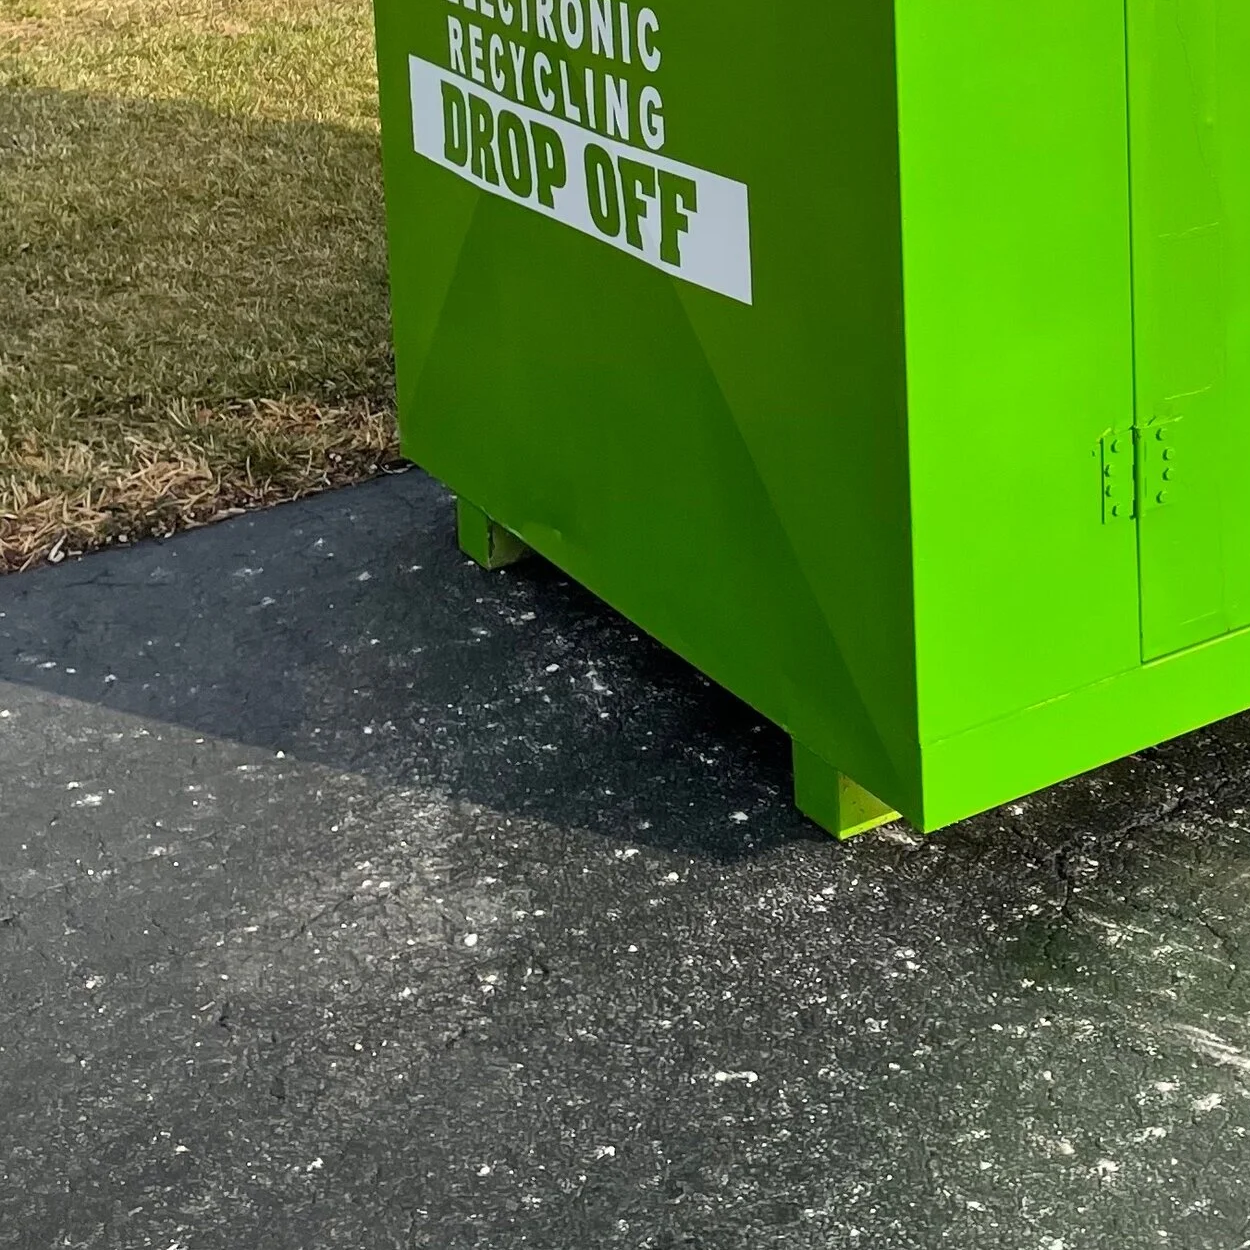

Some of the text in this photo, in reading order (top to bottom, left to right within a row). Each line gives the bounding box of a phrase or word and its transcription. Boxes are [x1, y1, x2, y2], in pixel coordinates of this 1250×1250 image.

[448, 15, 665, 151] RECYCLING
[441, 79, 698, 268] DROP OFF
